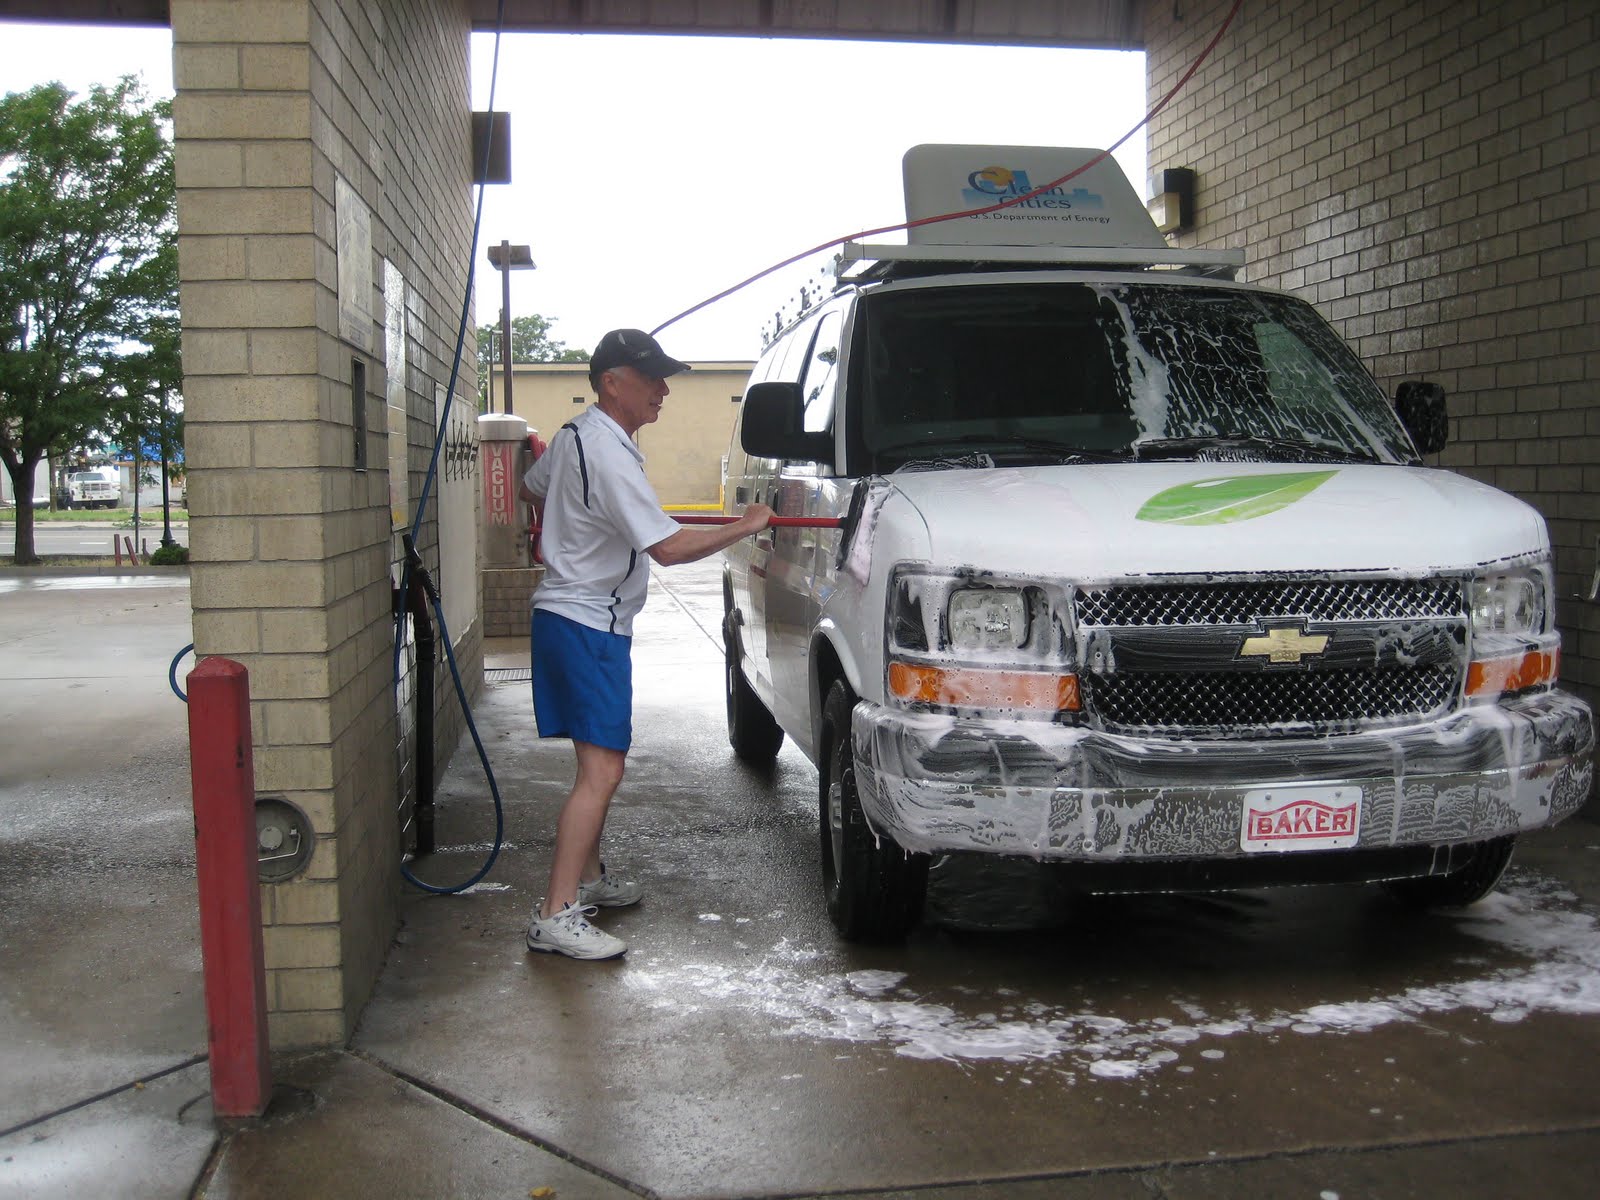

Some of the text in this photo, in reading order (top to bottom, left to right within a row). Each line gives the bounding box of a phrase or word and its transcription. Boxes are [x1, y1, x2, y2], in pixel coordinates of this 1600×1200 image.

[999, 196, 1071, 209] Cities
[993, 213, 1058, 221] Department
[1075, 215, 1110, 224] Energy
[492, 444, 508, 526] VACUUM
[1257, 808, 1347, 834] BAKER
